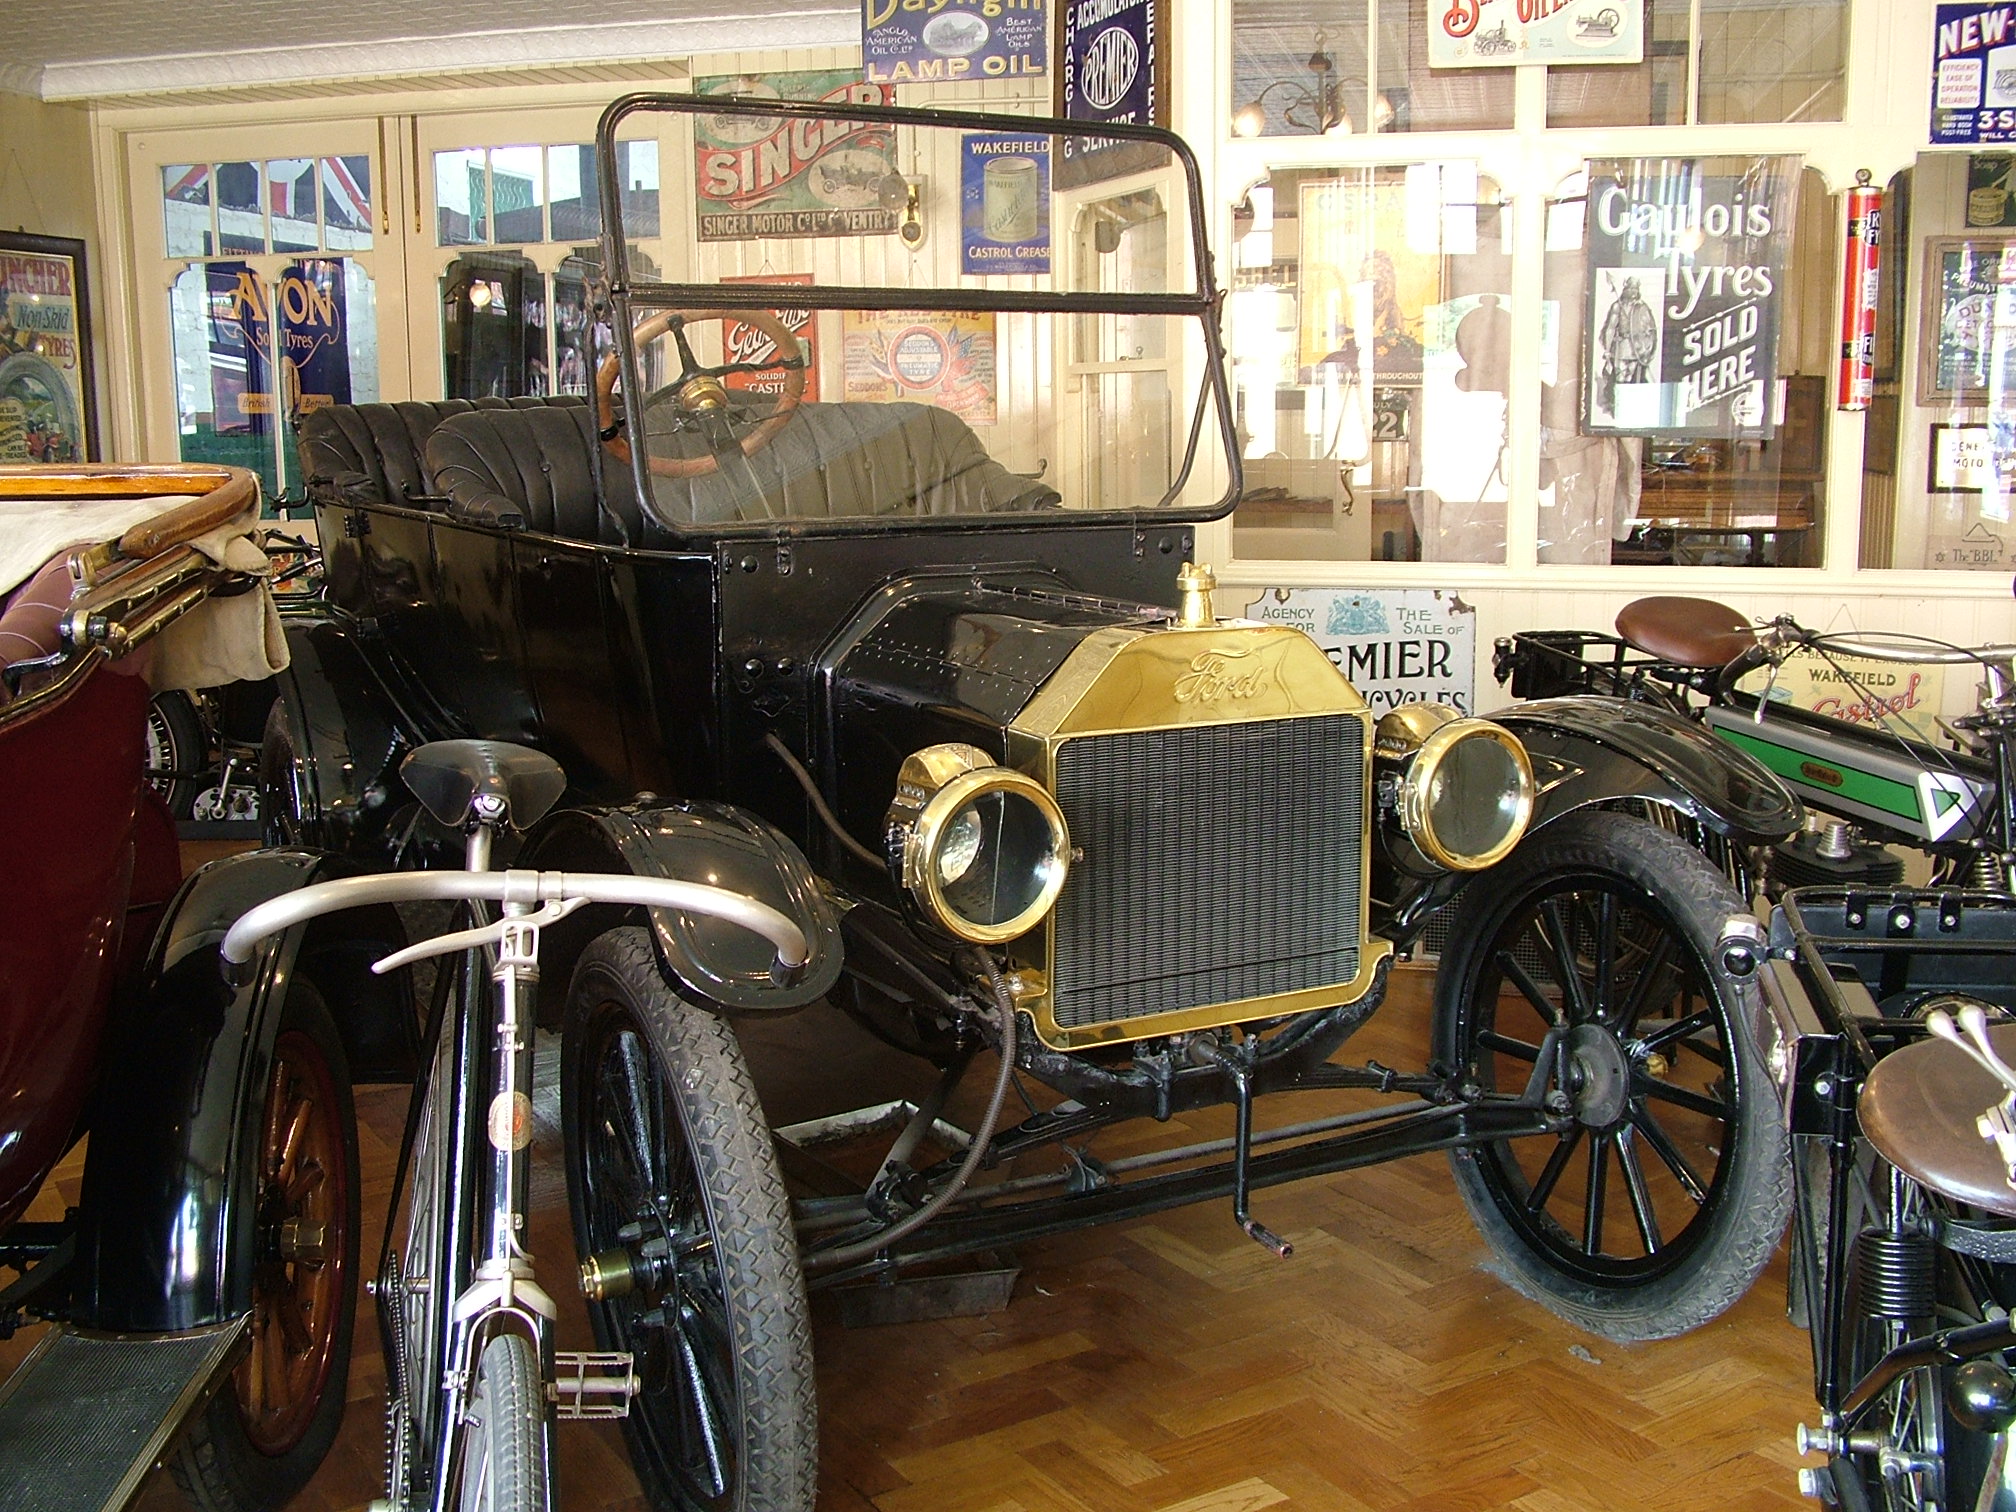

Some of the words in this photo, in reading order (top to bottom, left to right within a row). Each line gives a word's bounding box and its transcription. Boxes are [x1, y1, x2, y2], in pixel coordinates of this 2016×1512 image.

[1938, 8, 2016, 58] NEW-
[868, 57, 971, 82] LAMP
[983, 54, 1043, 75] OIL
[1064, 8, 1075, 158] CHARGIG
[1085, 31, 1137, 104] PREMIER
[704, 84, 886, 196] SINGER
[971, 141, 1050, 154] WAKEFIELD
[703, 215, 749, 235] SINGER
[752, 213, 794, 234] MOTOR
[1598, 186, 1772, 237] Gaulois
[969, 246, 1013, 258] CASTROL
[1016, 245, 1051, 258] GREASE
[1654, 247, 1773, 320] Tyres
[284, 330, 314, 351] Tyres
[1682, 305, 1759, 366] SOLD
[1373, 371, 1423, 381] THROUGHOUT
[1681, 344, 1757, 402] HERE
[1261, 606, 1315, 619] AGENCY
[1396, 607, 1433, 621] THE
[1403, 622, 1443, 635] SALE
[1174, 648, 1268, 703] Ford
[1324, 639, 1454, 683] EMIER
[1811, 672, 1921, 725] Castrol
